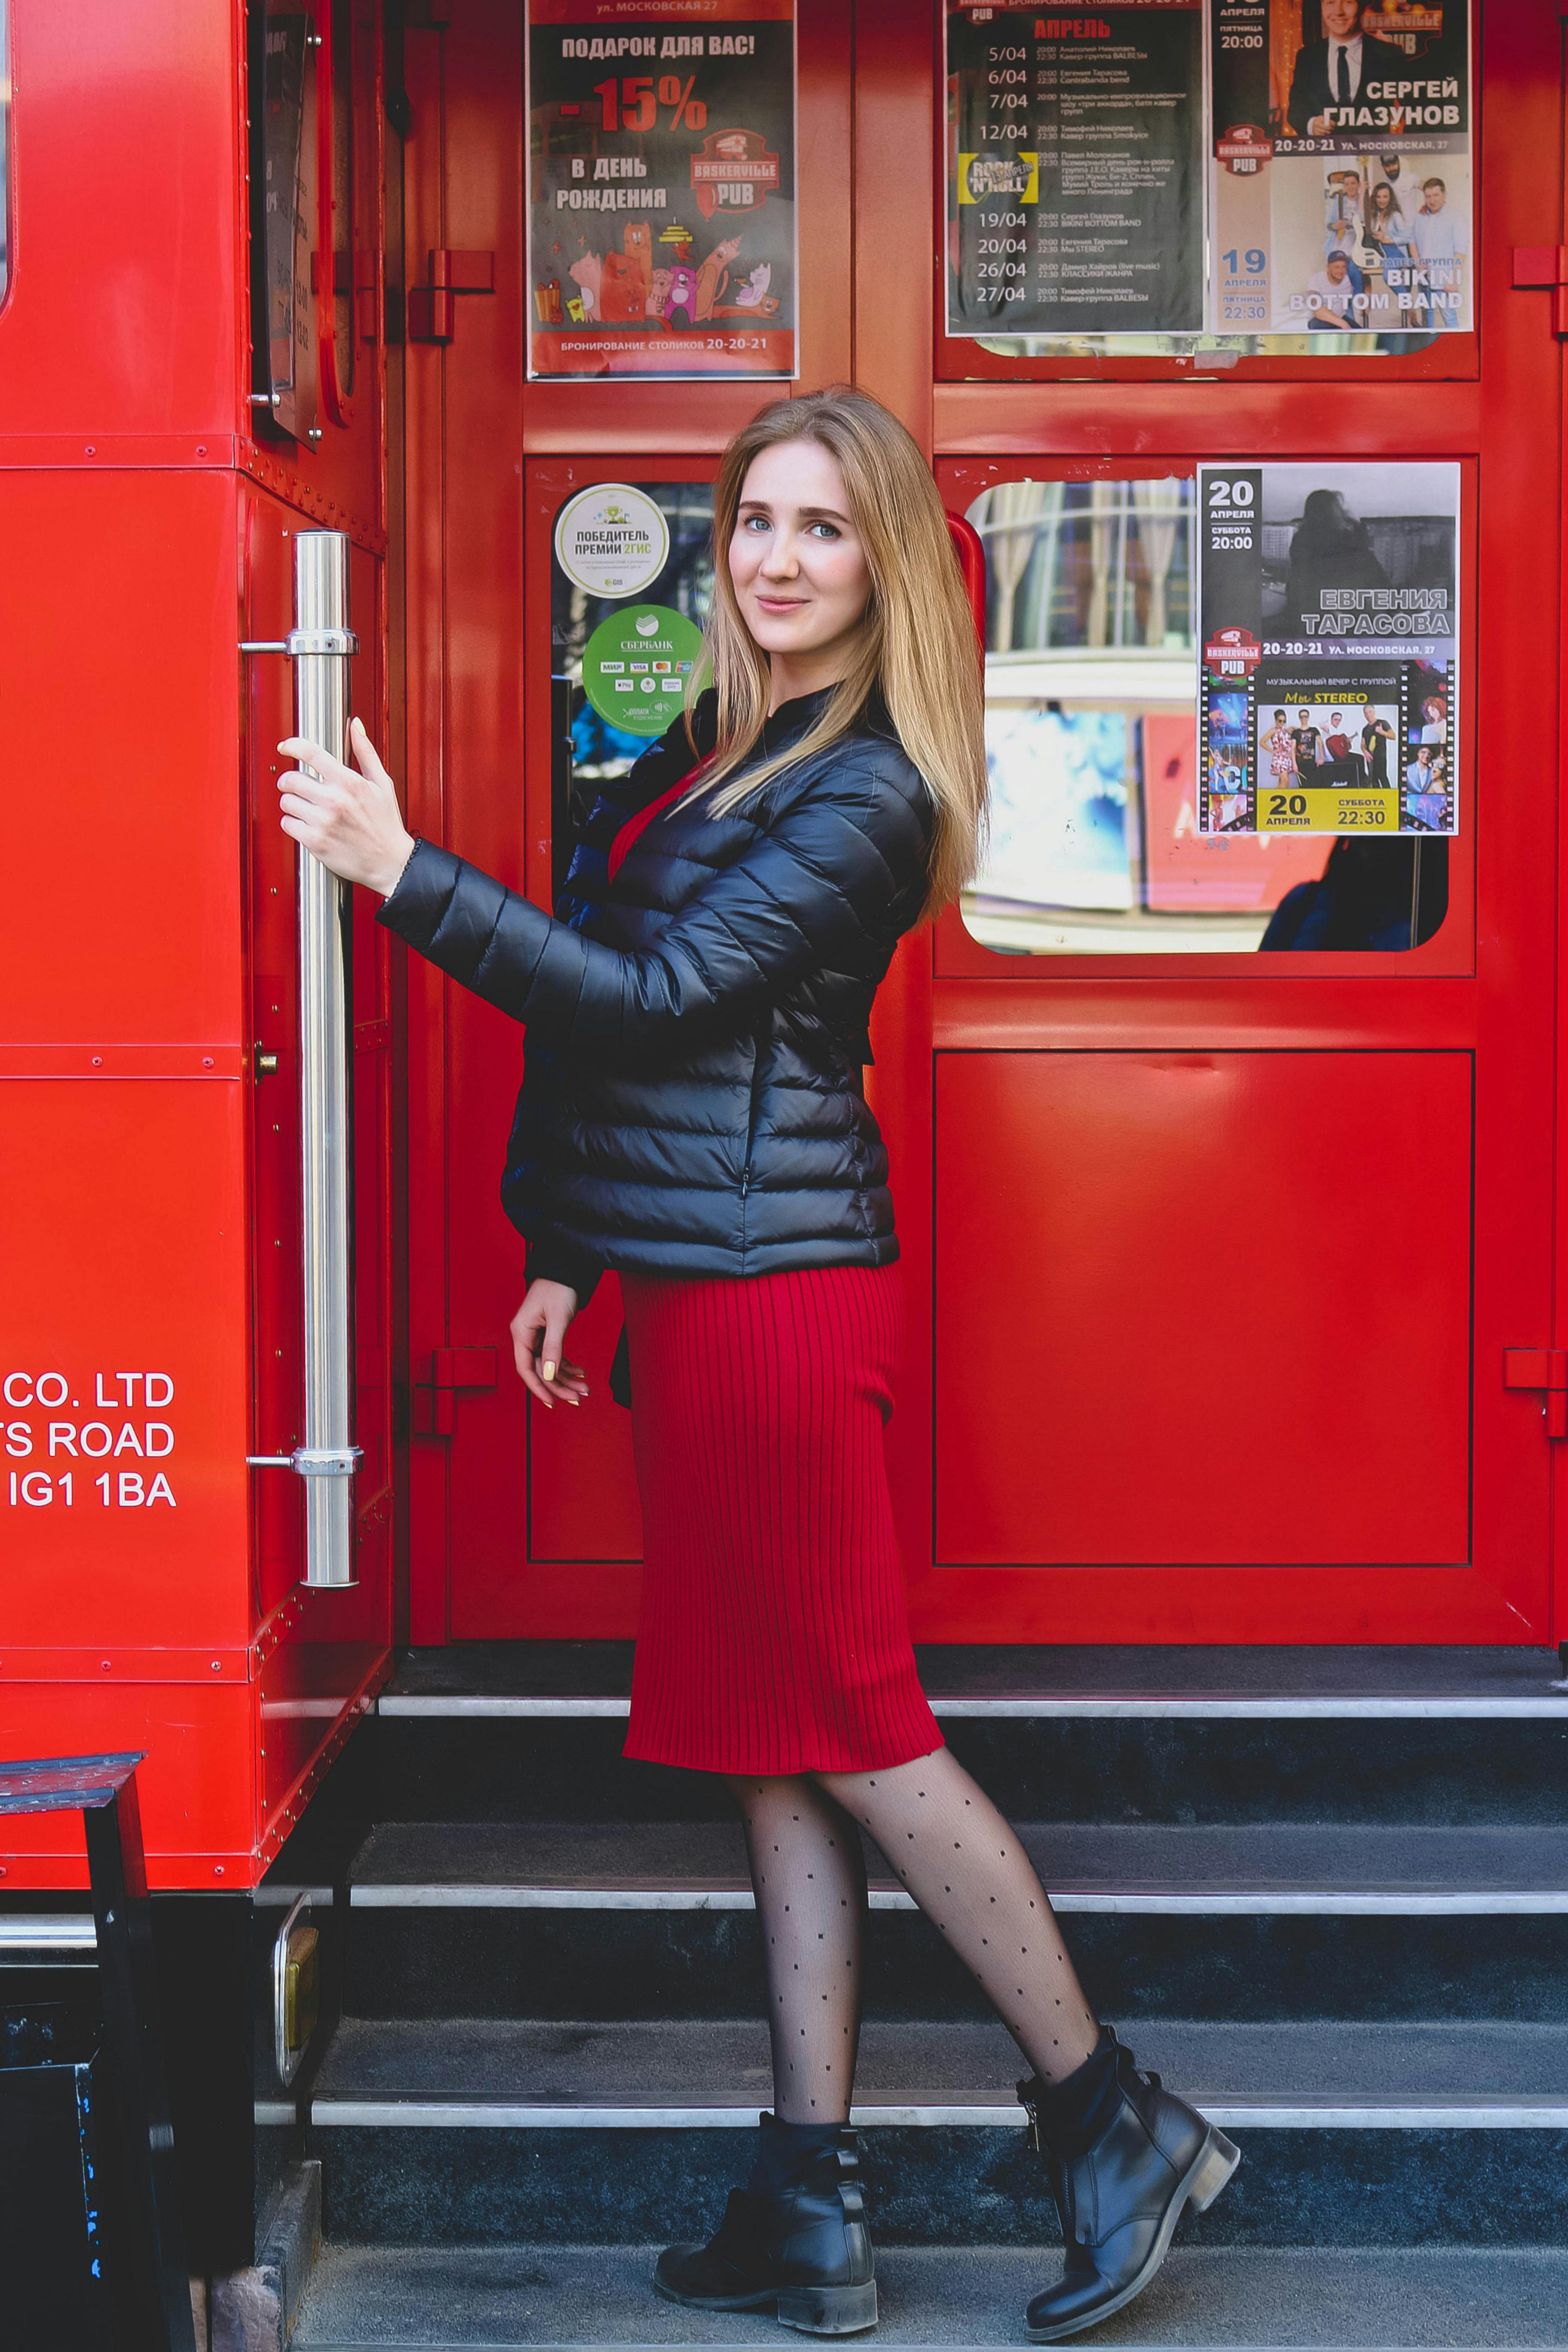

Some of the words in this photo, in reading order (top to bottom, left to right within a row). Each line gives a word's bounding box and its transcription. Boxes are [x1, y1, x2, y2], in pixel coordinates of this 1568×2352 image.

[597, 4, 613, 14] ул.
[616, 2, 701, 12] МОСКОВСКАЯ
[703, 1, 717, 10] 27
[972, 8, 993, 20] PUB
[1220, 8, 1265, 16] АПРЕЛЯ
[1034, 19, 1111, 39] АПРЕЛЬ
[562, 38, 655, 60] ПОДАРОК
[660, 37, 704, 58] ДЛЯ
[709, 36, 755, 55] ВАС!
[1221, 35, 1263, 49] 20:00
[989, 47, 1027, 61] 5/04
[989, 70, 1027, 84] 6/04
[1366, 77, 1458, 99] СЕРГЕЙ
[990, 94, 1028, 108] 7/04
[1323, 105, 1460, 127] ГЛАЗУНОВ
[980, 125, 1028, 140] 12/04
[1275, 139, 1336, 152] 20-20-21
[1437, 141, 1448, 150] 27
[572, 159, 585, 178] В
[593, 158, 647, 181] ДЕНЬ
[694, 164, 776, 178] BASKERVILLE
[1233, 158, 1257, 172] PUB
[557, 188, 667, 211] РОЖДЕНИЯ
[718, 183, 754, 205] PUB
[980, 213, 1027, 227] 19/04
[978, 239, 1027, 254] 20/04
[1222, 249, 1267, 274] 19
[978, 263, 1027, 278] 26/04
[1387, 270, 1462, 287] BIKINI
[977, 287, 1026, 302] 27/04
[1289, 293, 1389, 311] BOTTOM
[1398, 292, 1464, 309] BAND
[1224, 307, 1266, 319] 22:30
[561, 341, 646, 352] БРОНИРОВАНИЕ
[648, 340, 704, 351] СТОЛИКОВ
[707, 338, 767, 349] 20-20-21
[1209, 480, 1254, 506] 20
[1210, 510, 1255, 519] АПРЕЛЯ
[576, 530, 649, 543] ПОБЕДИТЕЛЬ
[1211, 536, 1253, 550] 20:00
[575, 544, 622, 555] ПРЕМИИ
[624, 543, 651, 554] 2ГИС
[1320, 588, 1447, 610] ЕВГЕНИЯ
[1301, 614, 1451, 635] ТАРАСОВА
[620, 640, 673, 649] СБЕРБАНК
[1263, 643, 1323, 655] 20-20-21
[1329, 646, 1344, 655] УЛ.
[1424, 646, 1435, 654] 27
[1207, 648, 1259, 659] BASKERVILLE
[1221, 660, 1245, 675] PUB
[1266, 677, 1327, 686] МУЗЫКАЛЬНЫЙ
[1360, 676, 1396, 686] ГРУППОЙ
[1284, 692, 1311, 704] Мы
[1314, 692, 1368, 704] STEREO
[1269, 794, 1307, 815] 20
[1338, 799, 1385, 807] СУББОТА
[1266, 817, 1311, 826] АПРЕЛЯ
[1338, 811, 1385, 825] 22:30
[3, 1372, 79, 1408] CO.
[96, 1372, 175, 1407] LTD
[0, 1421, 33, 1457] S
[49, 1422, 175, 1457] ROAD
[9, 1471, 72, 1507] IG1
[95, 1472, 177, 1507] 1BA
